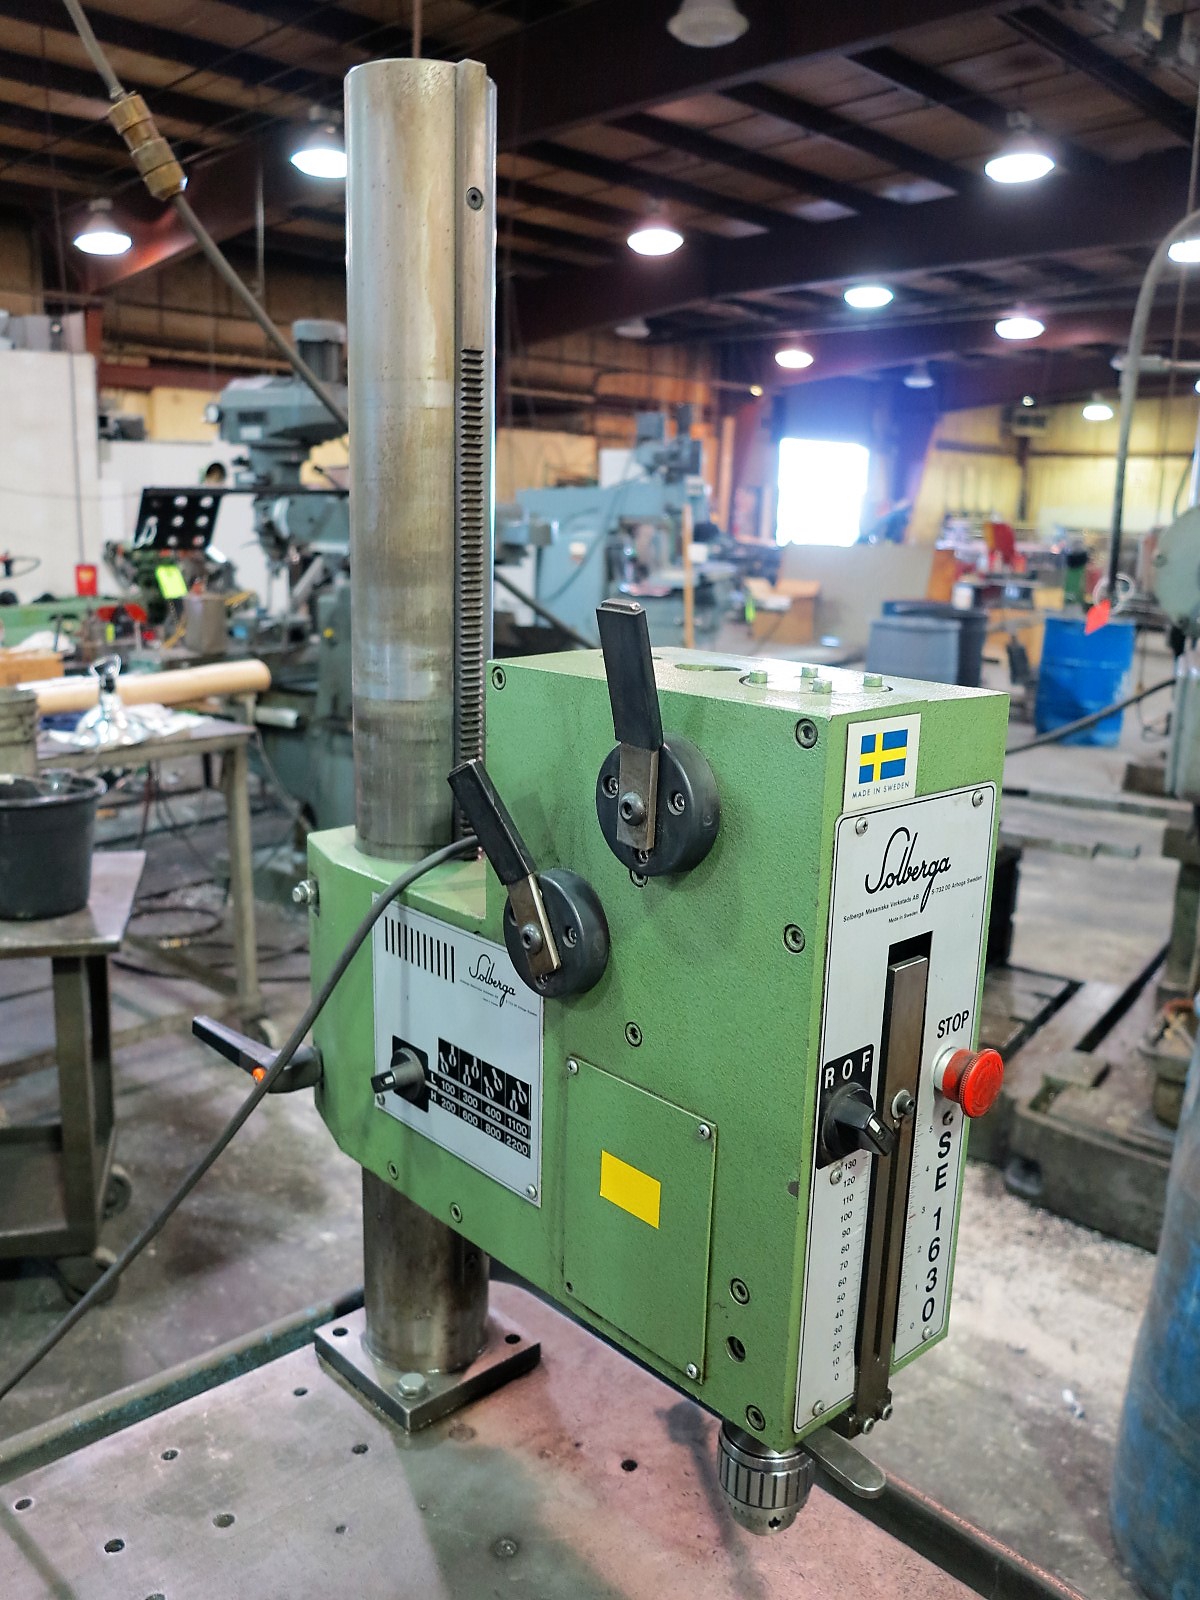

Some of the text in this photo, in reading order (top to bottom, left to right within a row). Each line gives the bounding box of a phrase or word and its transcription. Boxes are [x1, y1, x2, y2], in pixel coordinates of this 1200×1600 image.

[851, 781, 910, 799] MADE IN SWEDEN
[864, 826, 952, 914] Solberga
[468, 953, 516, 1008] Solberga
[936, 1010, 970, 1039] STOP
[824, 1050, 871, 1089] R O F
[430, 1072, 528, 1137] L 100 300 400 1100
[430, 1090, 528, 1156] H 200 600 800 2200
[844, 1158, 857, 1171] 130
[843, 1175, 856, 1188] 120
[843, 1193, 854, 1206] 110
[840, 1210, 853, 1223] 100
[841, 1227, 851, 1238] 90
[840, 1243, 850, 1255] 80
[840, 1260, 849, 1271] 70
[838, 1277, 847, 1288] 60
[836, 1292, 846, 1304] 50
[835, 1309, 844, 1319] 40
[833, 1324, 843, 1336] 30
[832, 1340, 842, 1352] 20
[832, 1356, 840, 1367] 10
